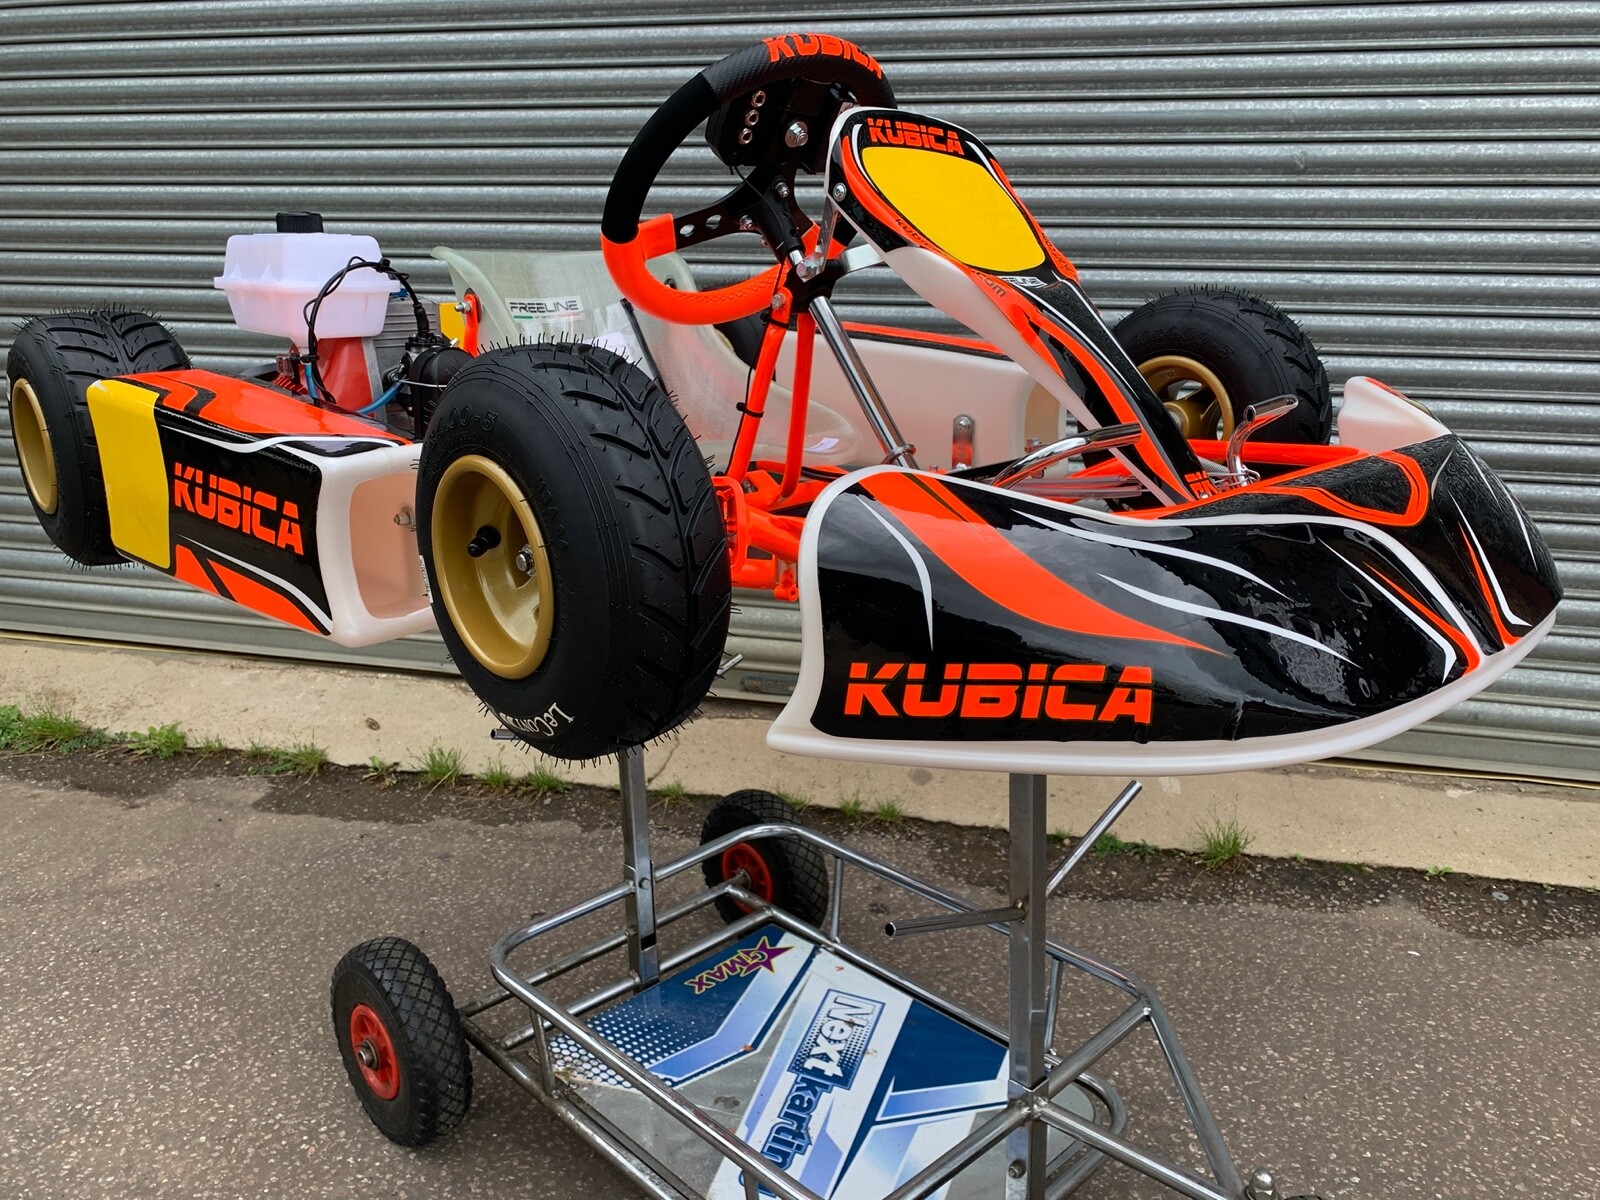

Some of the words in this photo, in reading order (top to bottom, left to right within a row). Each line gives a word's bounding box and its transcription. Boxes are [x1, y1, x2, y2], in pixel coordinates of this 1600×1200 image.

[762, 32, 882, 79] KUBICA
[867, 118, 965, 156] KUBICA
[509, 300, 579, 313] FREELINE
[173, 462, 304, 555] KUBICA
[844, 662, 1153, 724] KUBICA
[684, 949, 769, 994] GMAX
[803, 995, 877, 1077] Next
[742, 1075, 832, 1188] kartin
